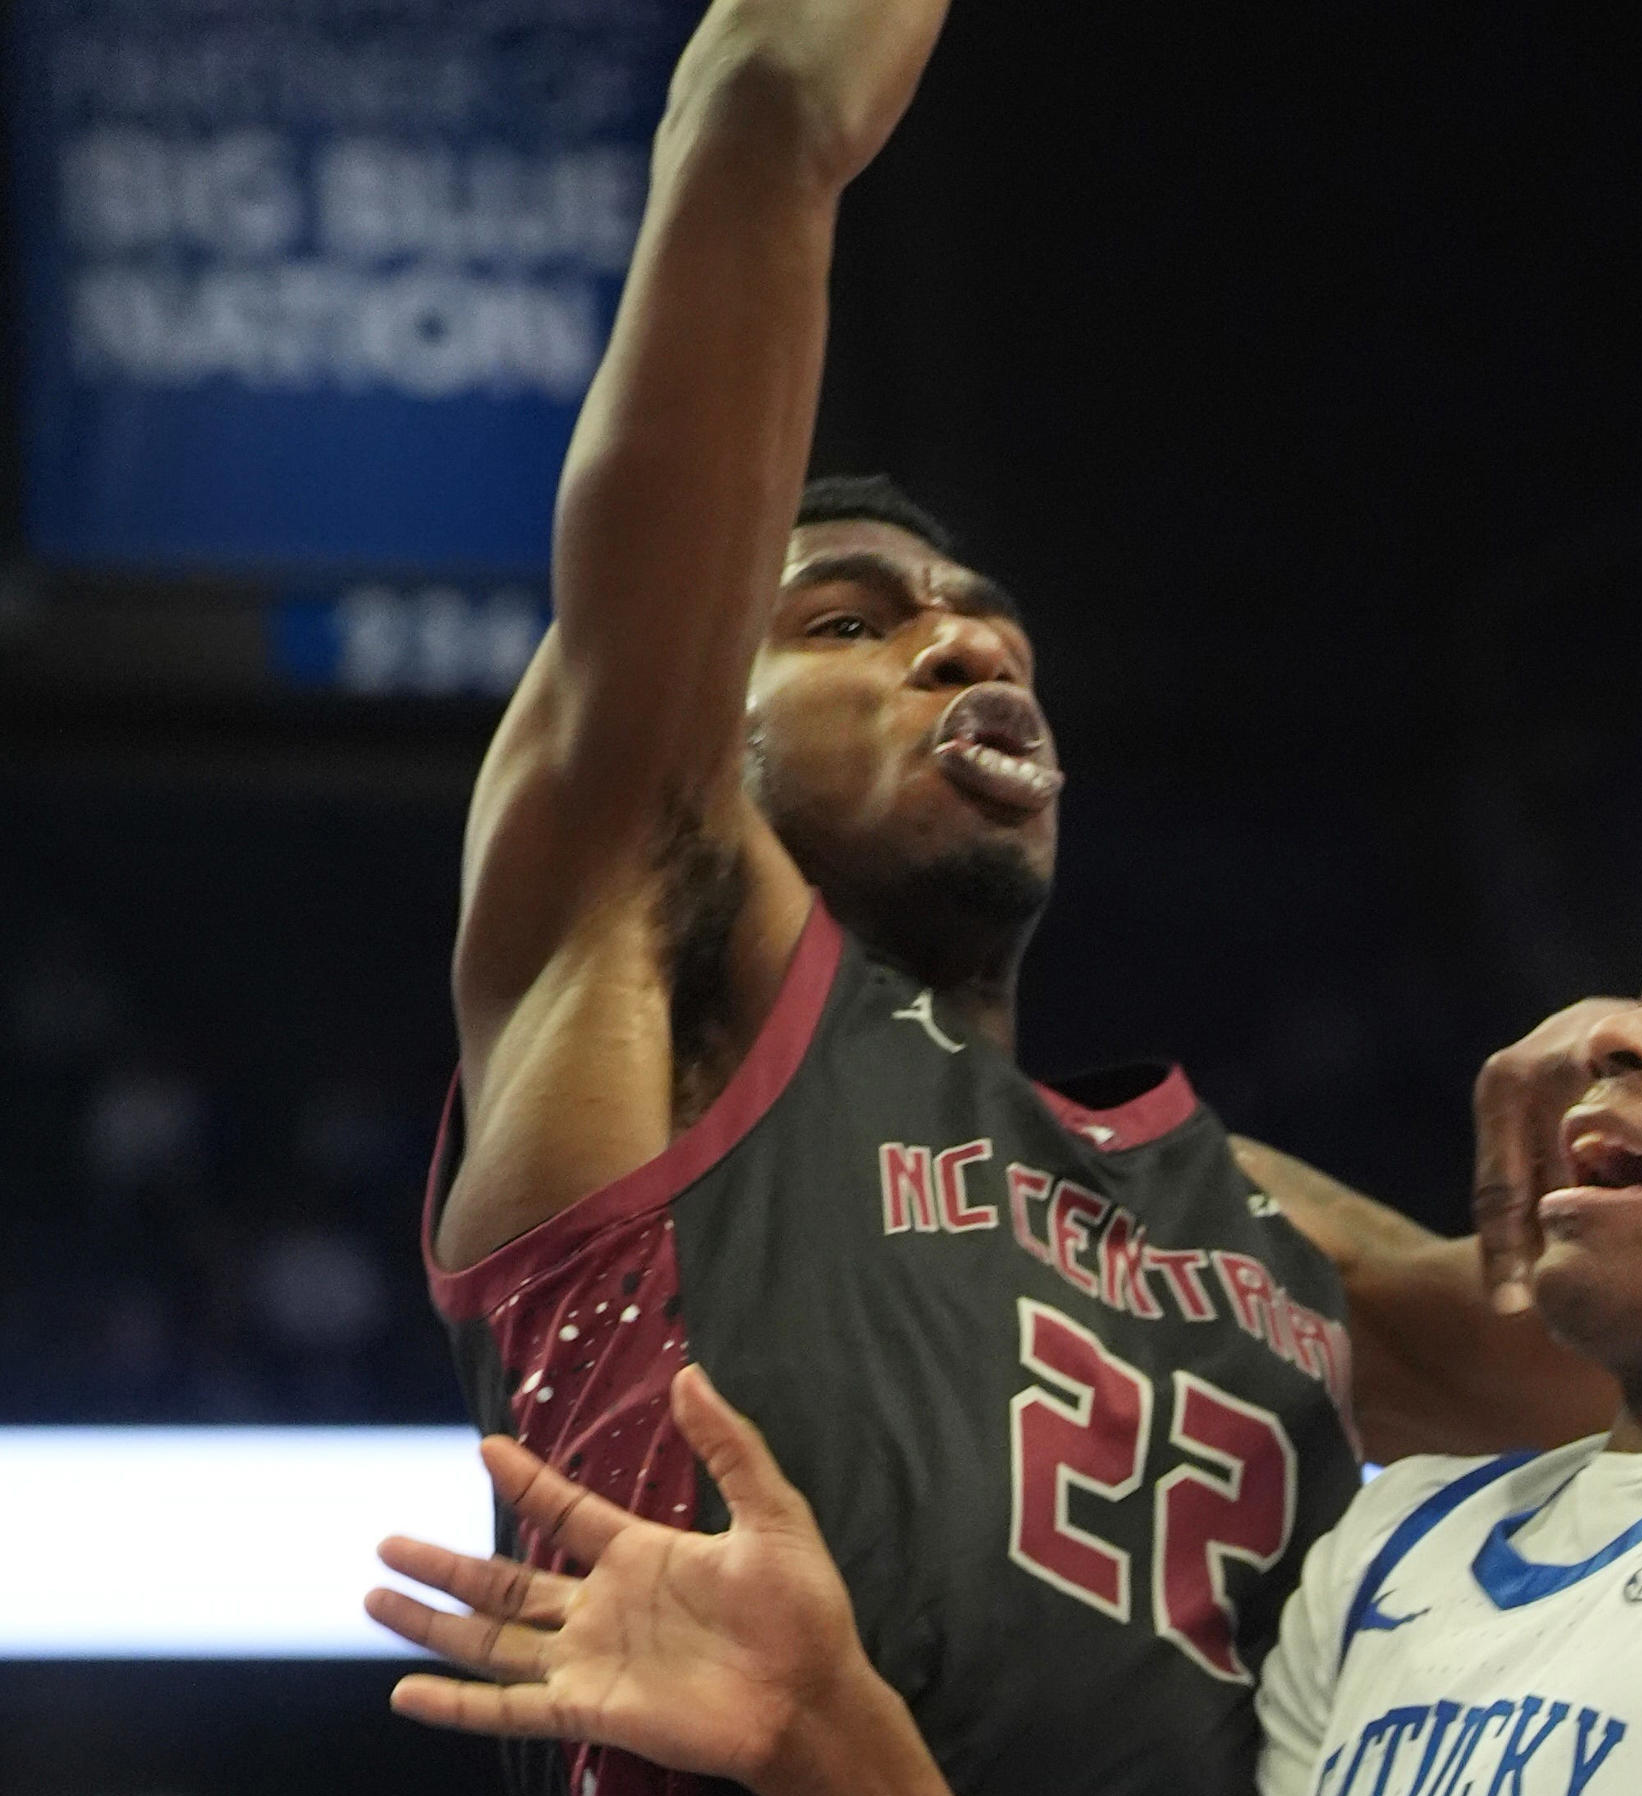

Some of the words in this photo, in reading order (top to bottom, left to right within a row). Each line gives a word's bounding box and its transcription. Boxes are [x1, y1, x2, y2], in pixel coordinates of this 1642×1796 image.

[66, 130, 296, 250] BIG
[76, 264, 597, 387] NATION
[880, 1138, 998, 1235] NC
[1009, 1297, 1298, 1686] 22
